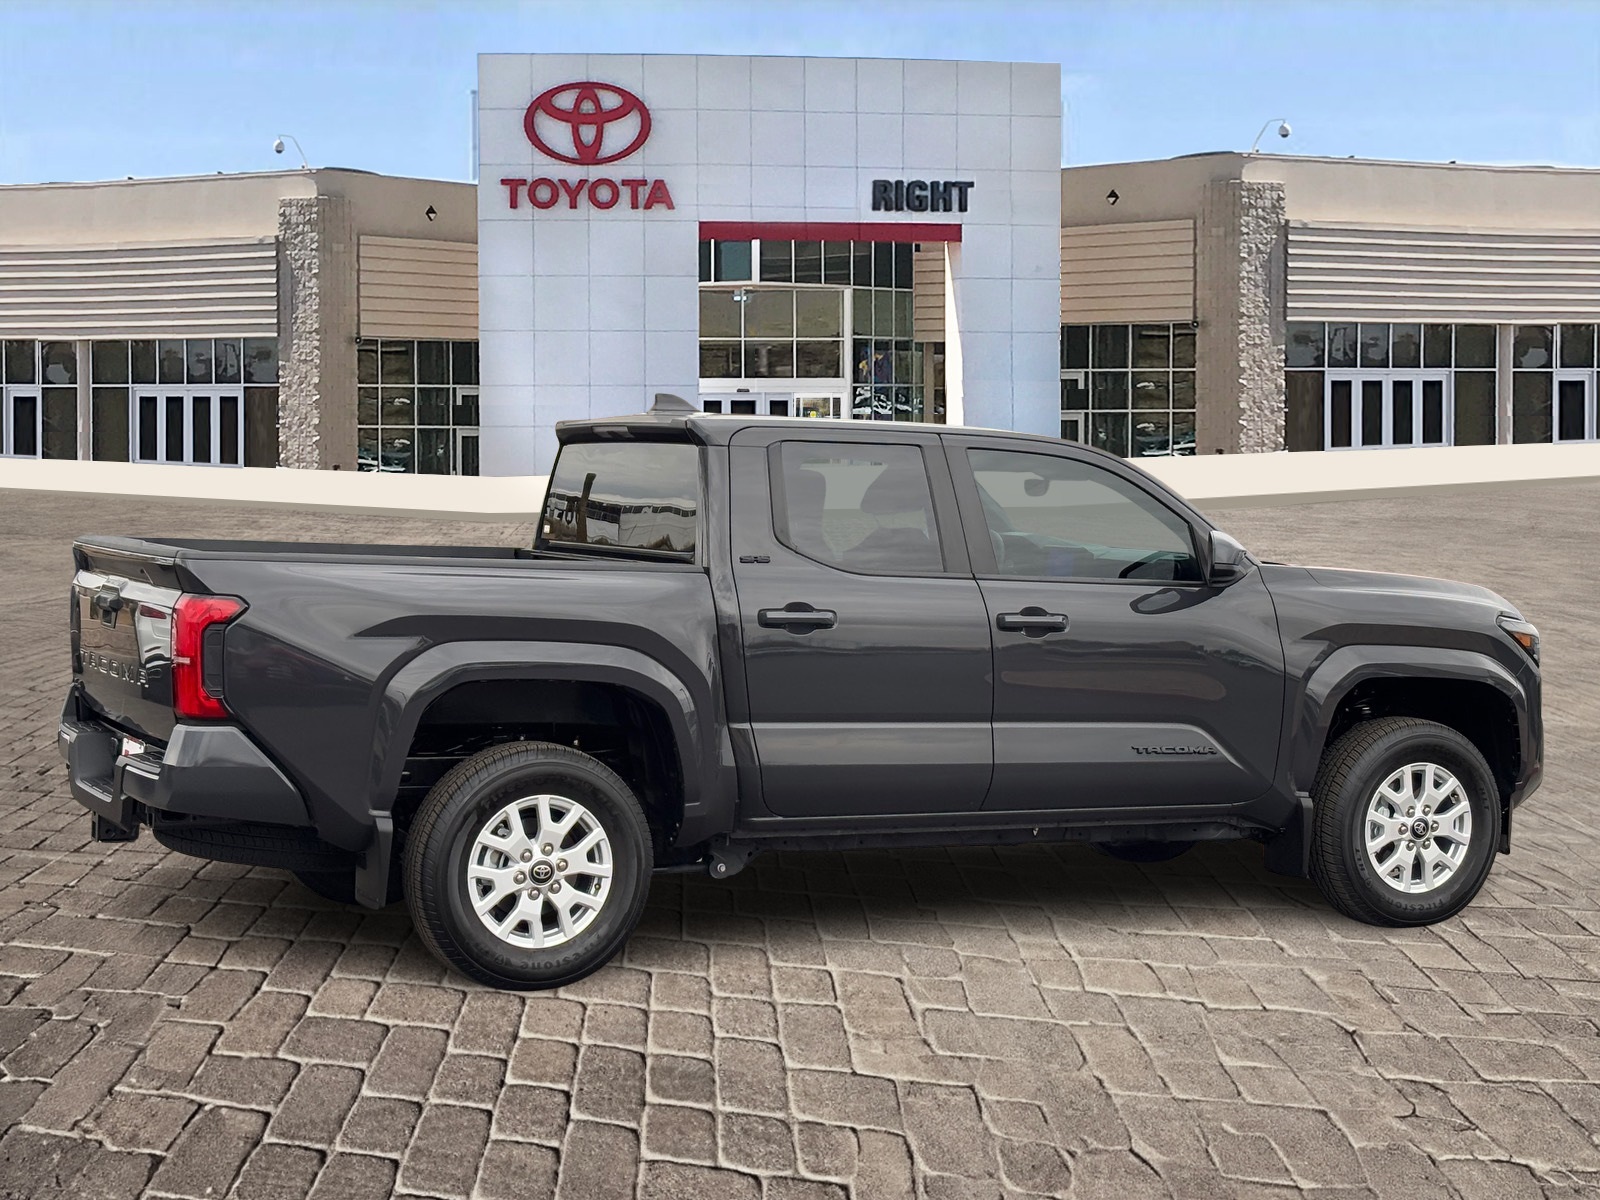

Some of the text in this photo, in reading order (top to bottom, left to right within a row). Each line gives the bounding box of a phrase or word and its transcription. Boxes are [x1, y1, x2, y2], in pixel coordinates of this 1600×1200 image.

[500, 178, 675, 210] TOYOTA
[872, 180, 975, 212] RIGHT
[80, 648, 149, 688] TACOMA
[1131, 745, 1218, 755] TACOMA
